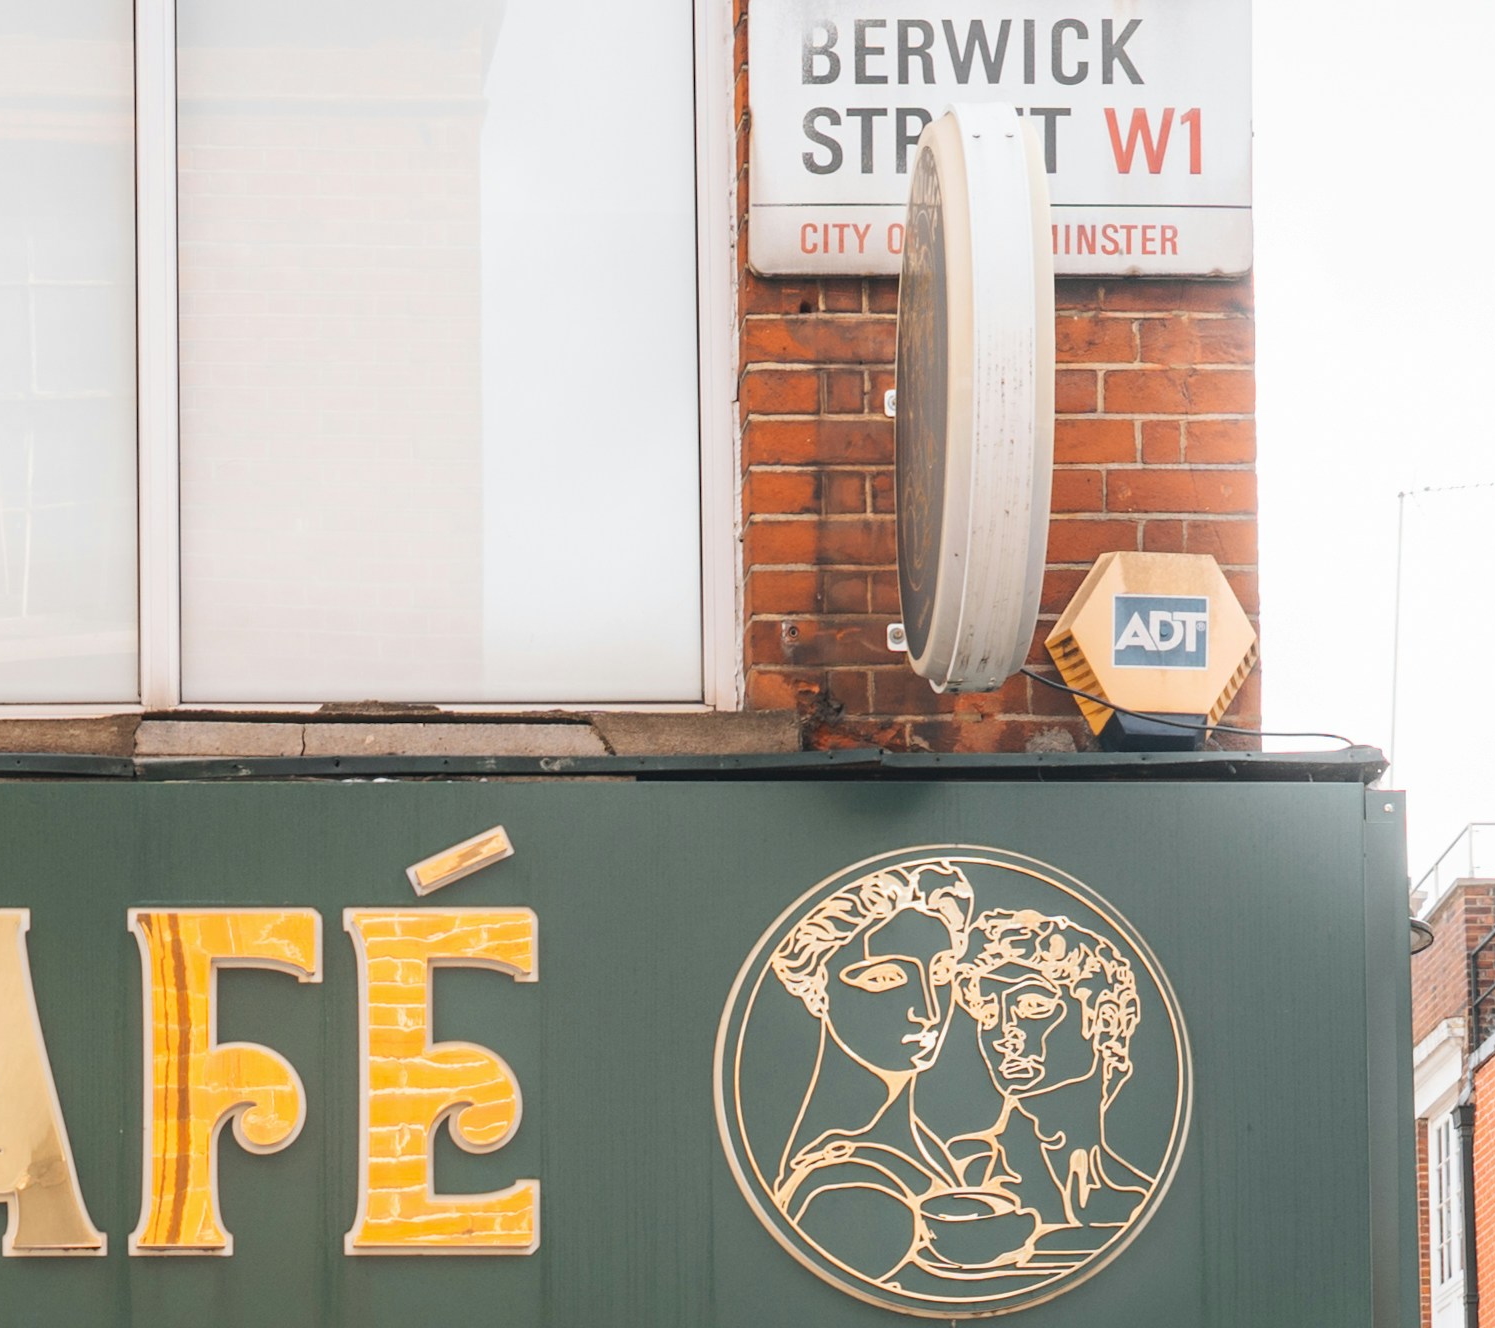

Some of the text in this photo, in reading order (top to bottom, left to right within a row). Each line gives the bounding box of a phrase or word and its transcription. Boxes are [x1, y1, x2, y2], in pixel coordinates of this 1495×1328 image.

[801, 18, 1146, 85] BERWICK
[801, 106, 1202, 176] STRT W1
[800, 223, 872, 255] CITY
[1115, 611, 1205, 651] ADT
